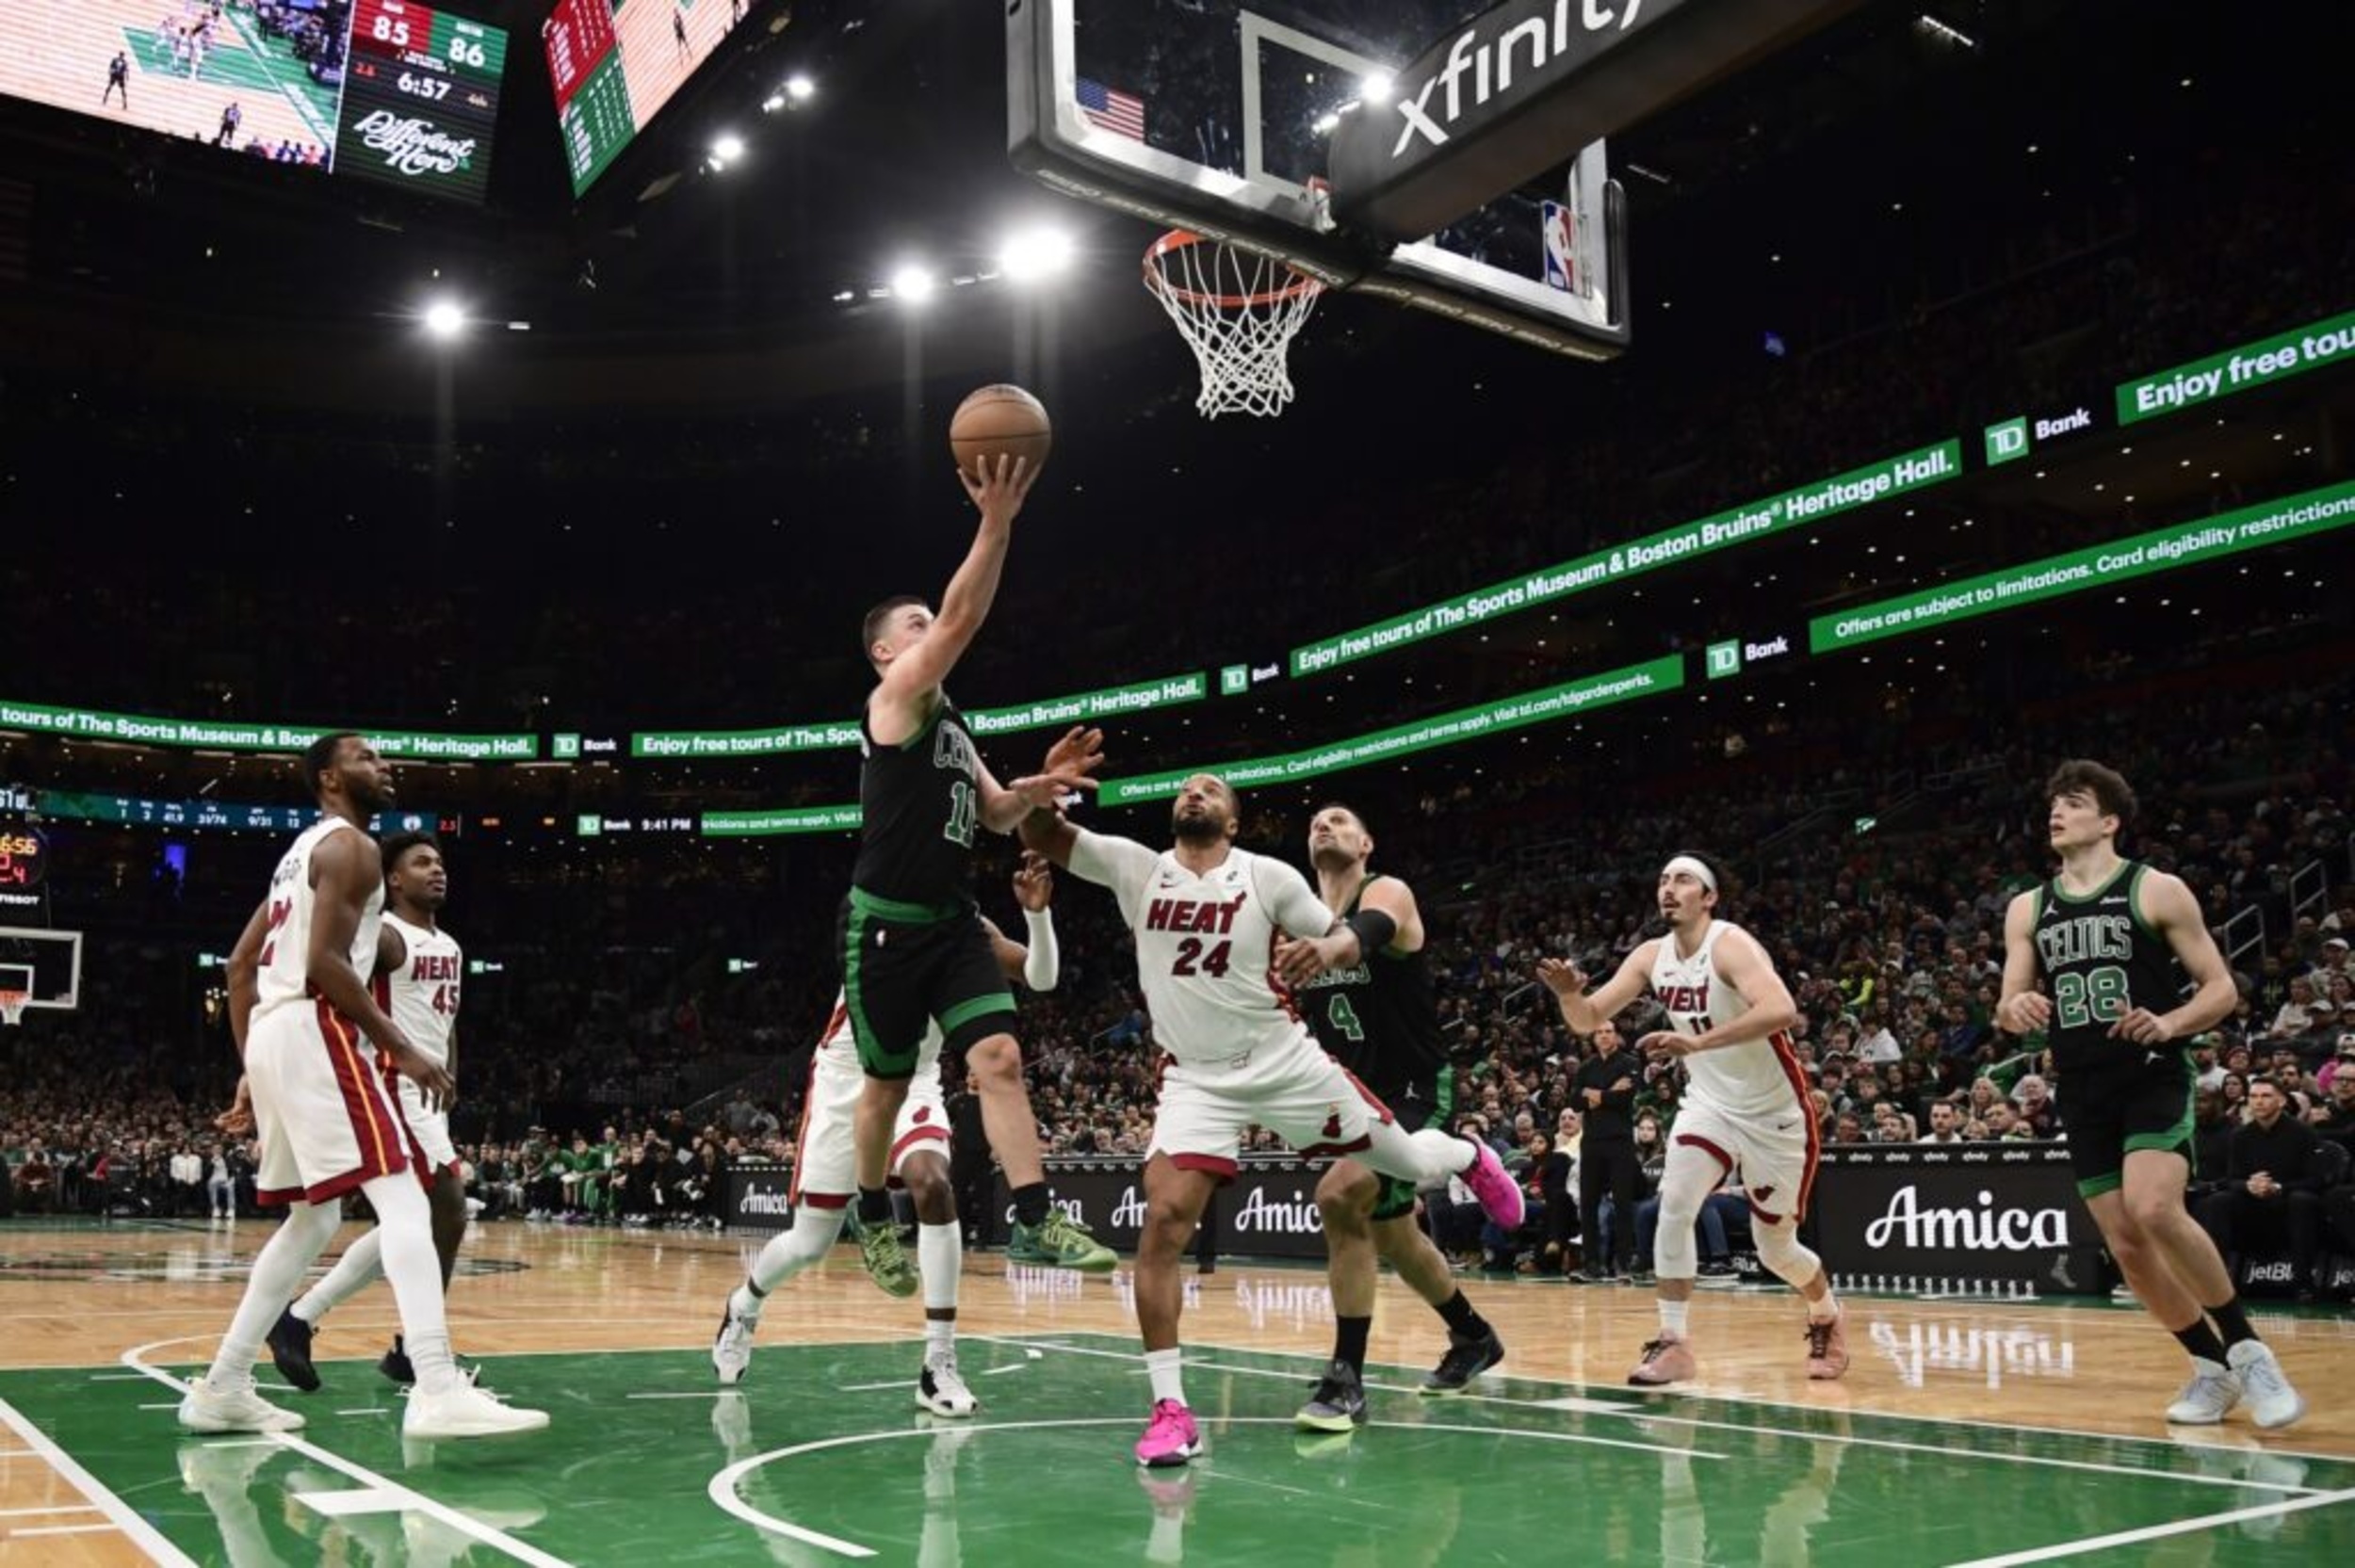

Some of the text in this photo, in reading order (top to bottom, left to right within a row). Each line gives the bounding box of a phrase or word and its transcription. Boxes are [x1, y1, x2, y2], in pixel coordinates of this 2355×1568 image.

[372, 15, 410, 46] 85
[448, 37, 486, 67] 86
[398, 72, 451, 100] 6:57
[1392, 0, 1642, 158] xfinit
[353, 110, 477, 158] Different
[385, 143, 459, 175] Here
[1990, 427, 2024, 455] TD
[2035, 408, 2091, 440] Bank
[2136, 367, 2223, 412] Enjoy
[2228, 345, 2298, 384] free
[1299, 647, 1338, 671] Enjoy
[1340, 638, 1371, 657] free
[1372, 625, 1413, 645] tours
[1415, 615, 1433, 635] of
[1435, 607, 1464, 628] The
[1467, 590, 1524, 619] Sports
[1526, 562, 1606, 600] Museum
[1608, 553, 1626, 574] &
[1628, 531, 1698, 568] Boston
[1786, 471, 1891, 520] Heritage
[1893, 449, 1954, 487] Hall.
[1835, 613, 1883, 639] Offers
[1885, 608, 1912, 627] are
[1914, 591, 1974, 621] subject
[1975, 588, 1994, 604] to
[1996, 562, 2093, 598] limitations.
[2096, 548, 2143, 573] Card
[2147, 526, 2236, 560] eligibility
[1711, 636, 1789, 669] TD Bank
[1226, 664, 1279, 688] TD Bank
[975, 710, 1031, 731] Boston
[1090, 687, 1160, 713] Heritage
[1162, 679, 1201, 700] Hall.
[1, 708, 51, 726] tours
[55, 712, 74, 730] of
[78, 713, 113, 734] The
[116, 719, 176, 739] Sports
[180, 726, 258, 744] Museum
[261, 729, 275, 745] &
[279, 730, 318, 747] Bost
[413, 737, 490, 757] Heritage
[493, 738, 533, 753] Hall.
[558, 737, 616, 752] TD Bank
[642, 727, 863, 754] Enjoy free tours of The Spo
[1226, 766, 1286, 783] limitations.
[1288, 758, 1312, 774] Card
[1311, 749, 1353, 770] eligibility
[1354, 736, 1407, 758] restrictions
[1409, 729, 1429, 744] and
[1430, 724, 1459, 740] terms
[1459, 715, 1492, 736] apply.
[1494, 706, 1518, 722] Visit
[1519, 673, 1653, 717] td.com/tdgardenperks.
[1120, 782, 1153, 798] Offers
[1154, 781, 1171, 792] are
[604, 818, 632, 832] Bank
[642, 817, 692, 831] 9:41 PM
[749, 816, 769, 829] and
[1146, 891, 1247, 934] HEAT
[1172, 937, 1232, 978] 24
[2037, 914, 2133, 973] CELTICS
[412, 953, 460, 981] HEAT
[432, 985, 460, 1015] 45
[2055, 965, 2133, 1028] 28
[1329, 993, 1364, 1041] 4
[739, 1182, 788, 1216] Amica
[1235, 1187, 1324, 1233] Amic
[1865, 1185, 2071, 1250] Amica
